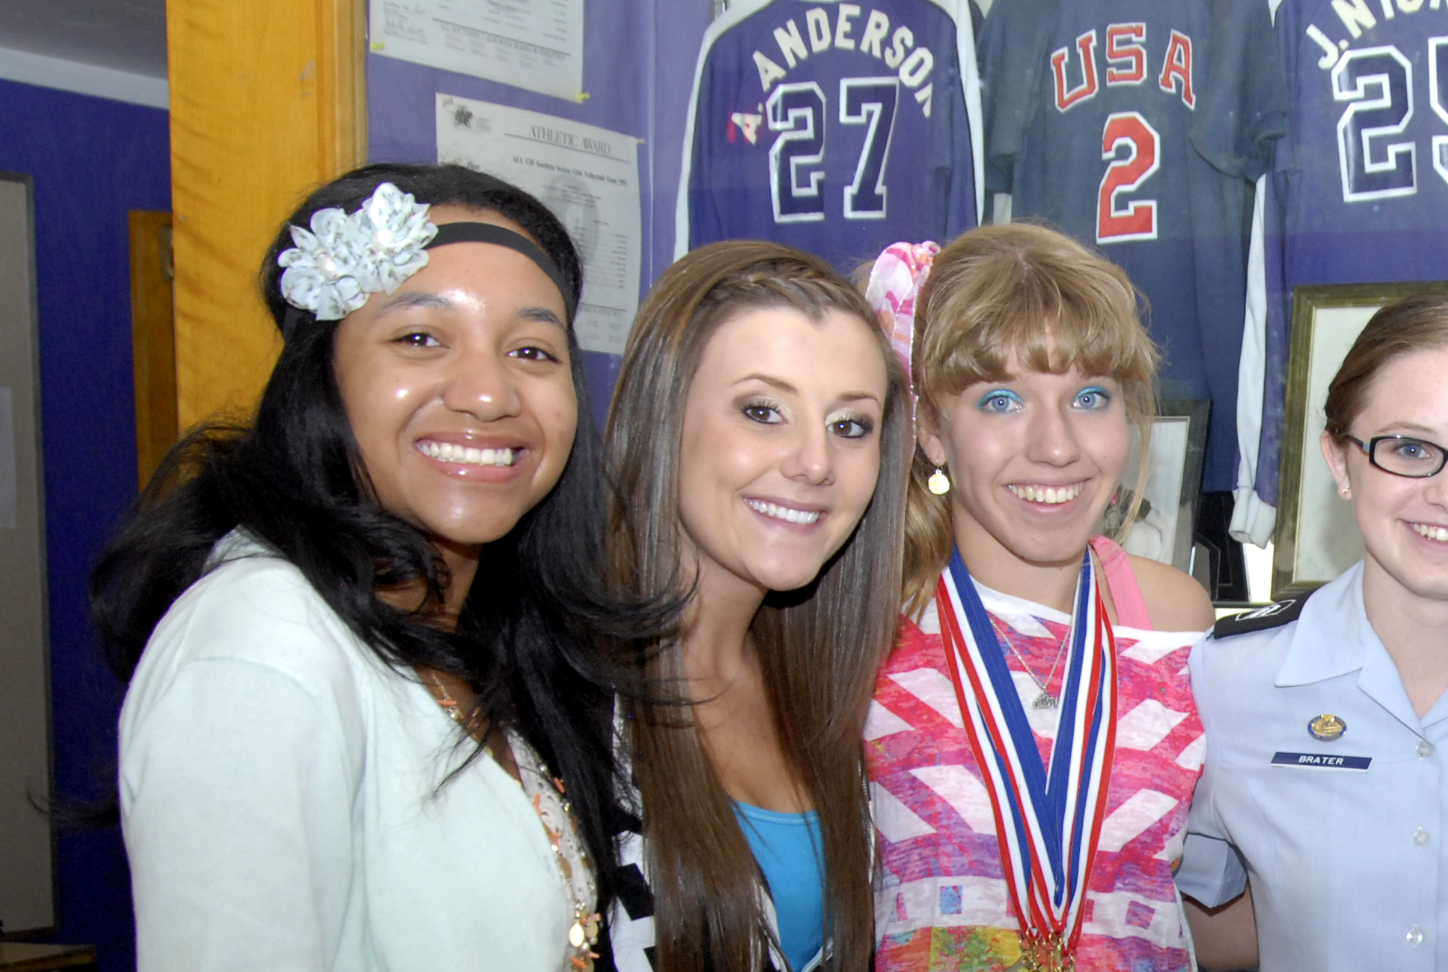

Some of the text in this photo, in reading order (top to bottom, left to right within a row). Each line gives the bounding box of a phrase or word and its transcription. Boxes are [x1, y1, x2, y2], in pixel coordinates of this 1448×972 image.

[1051, 22, 1195, 112] USA
[531, 125, 611, 154] ATHLETIC AWARD
[766, 76, 900, 223] 27
[1096, 111, 1160, 244] 2
[1298, 755, 1344, 765] BRATER
